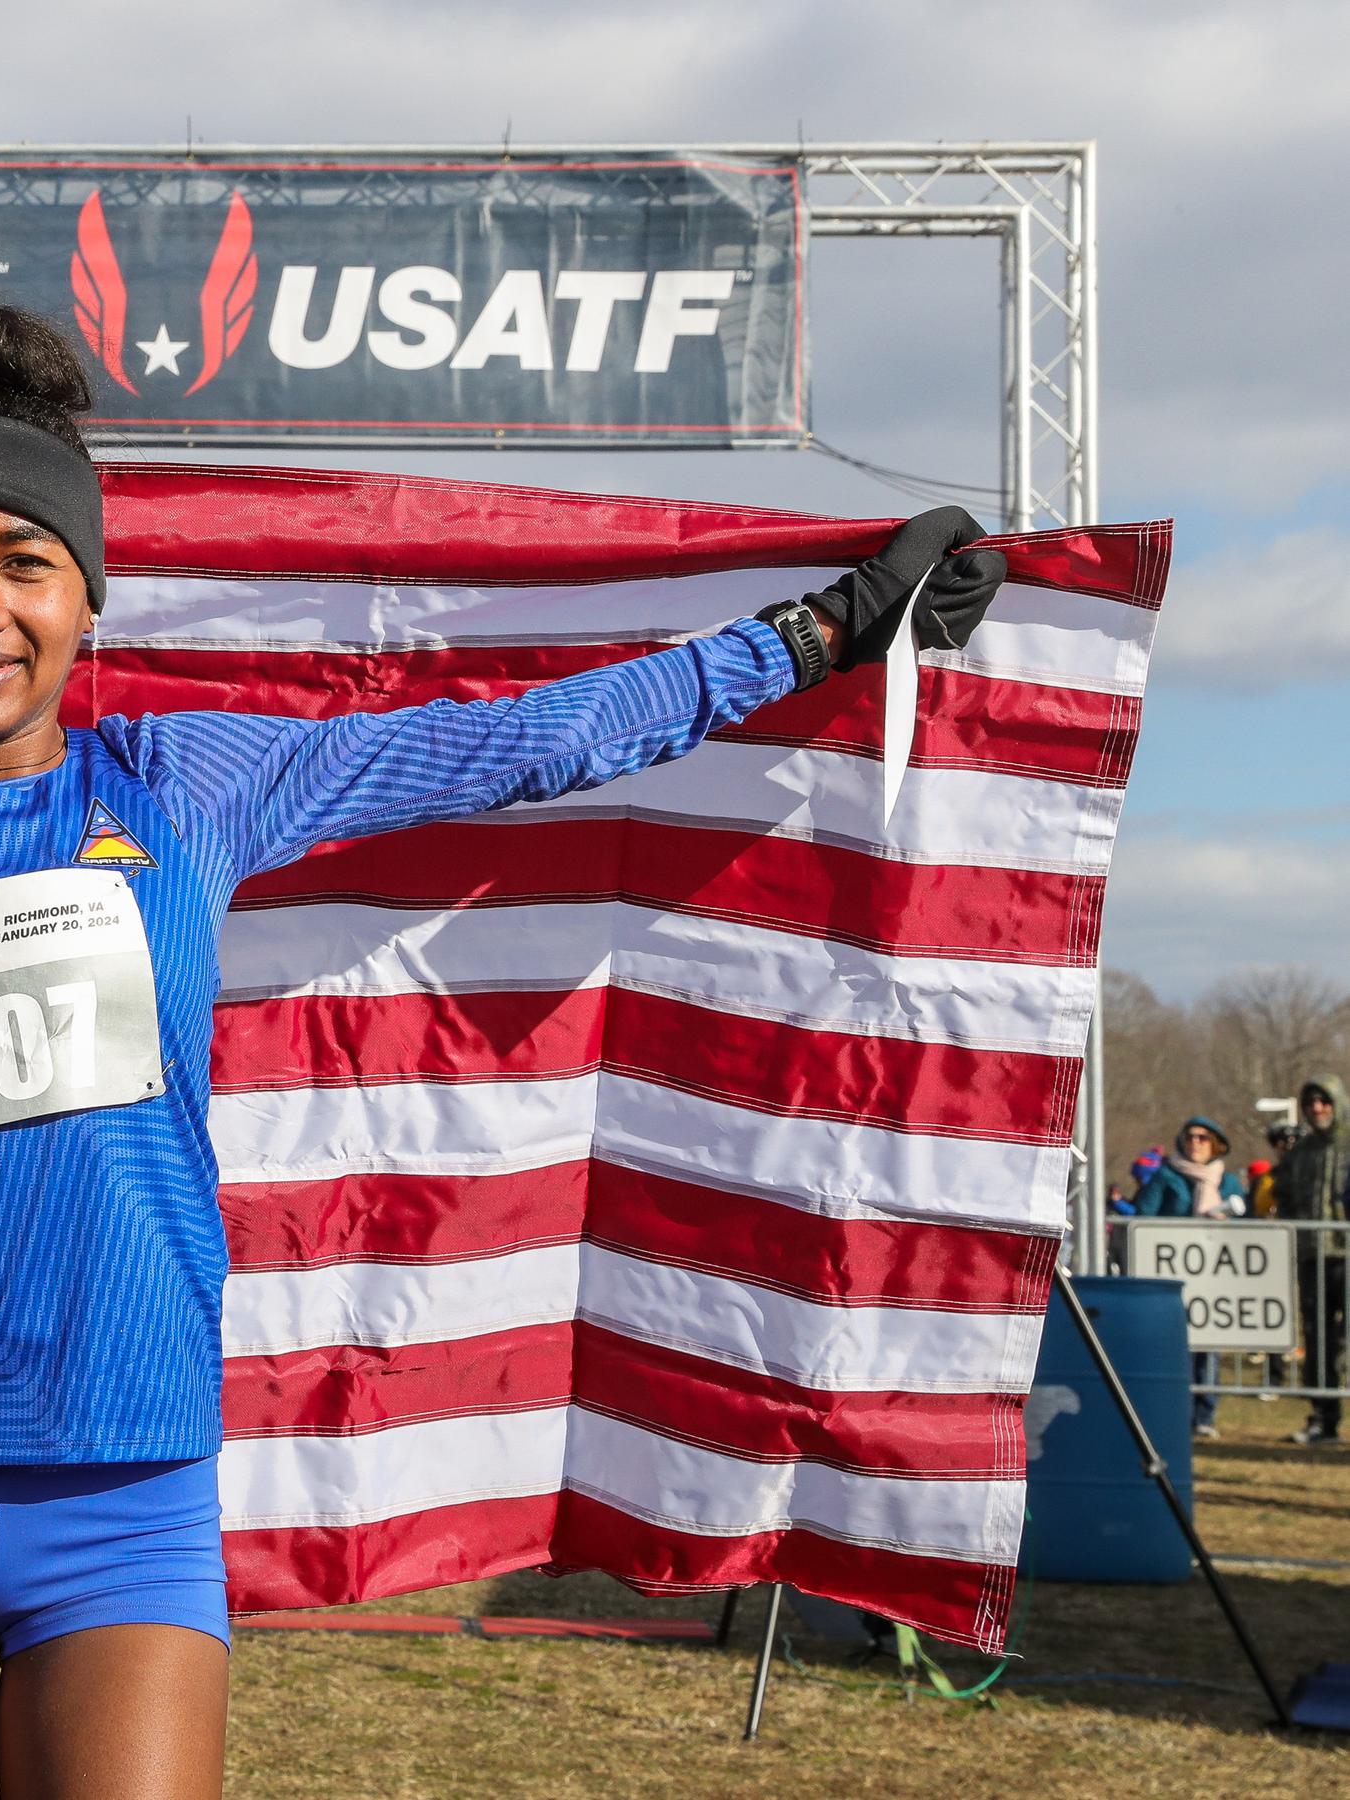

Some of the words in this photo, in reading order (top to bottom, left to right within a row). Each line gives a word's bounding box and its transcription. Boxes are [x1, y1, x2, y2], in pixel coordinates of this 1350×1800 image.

[268, 265, 736, 374] USATF
[3, 904, 84, 926] RICHMOND,
[88, 902, 105, 912] VA
[62, 920, 83, 931] 20,
[88, 915, 120, 928] 2024
[1155, 1243, 1268, 1276] ROAD
[1187, 1297, 1286, 1329] OSED
